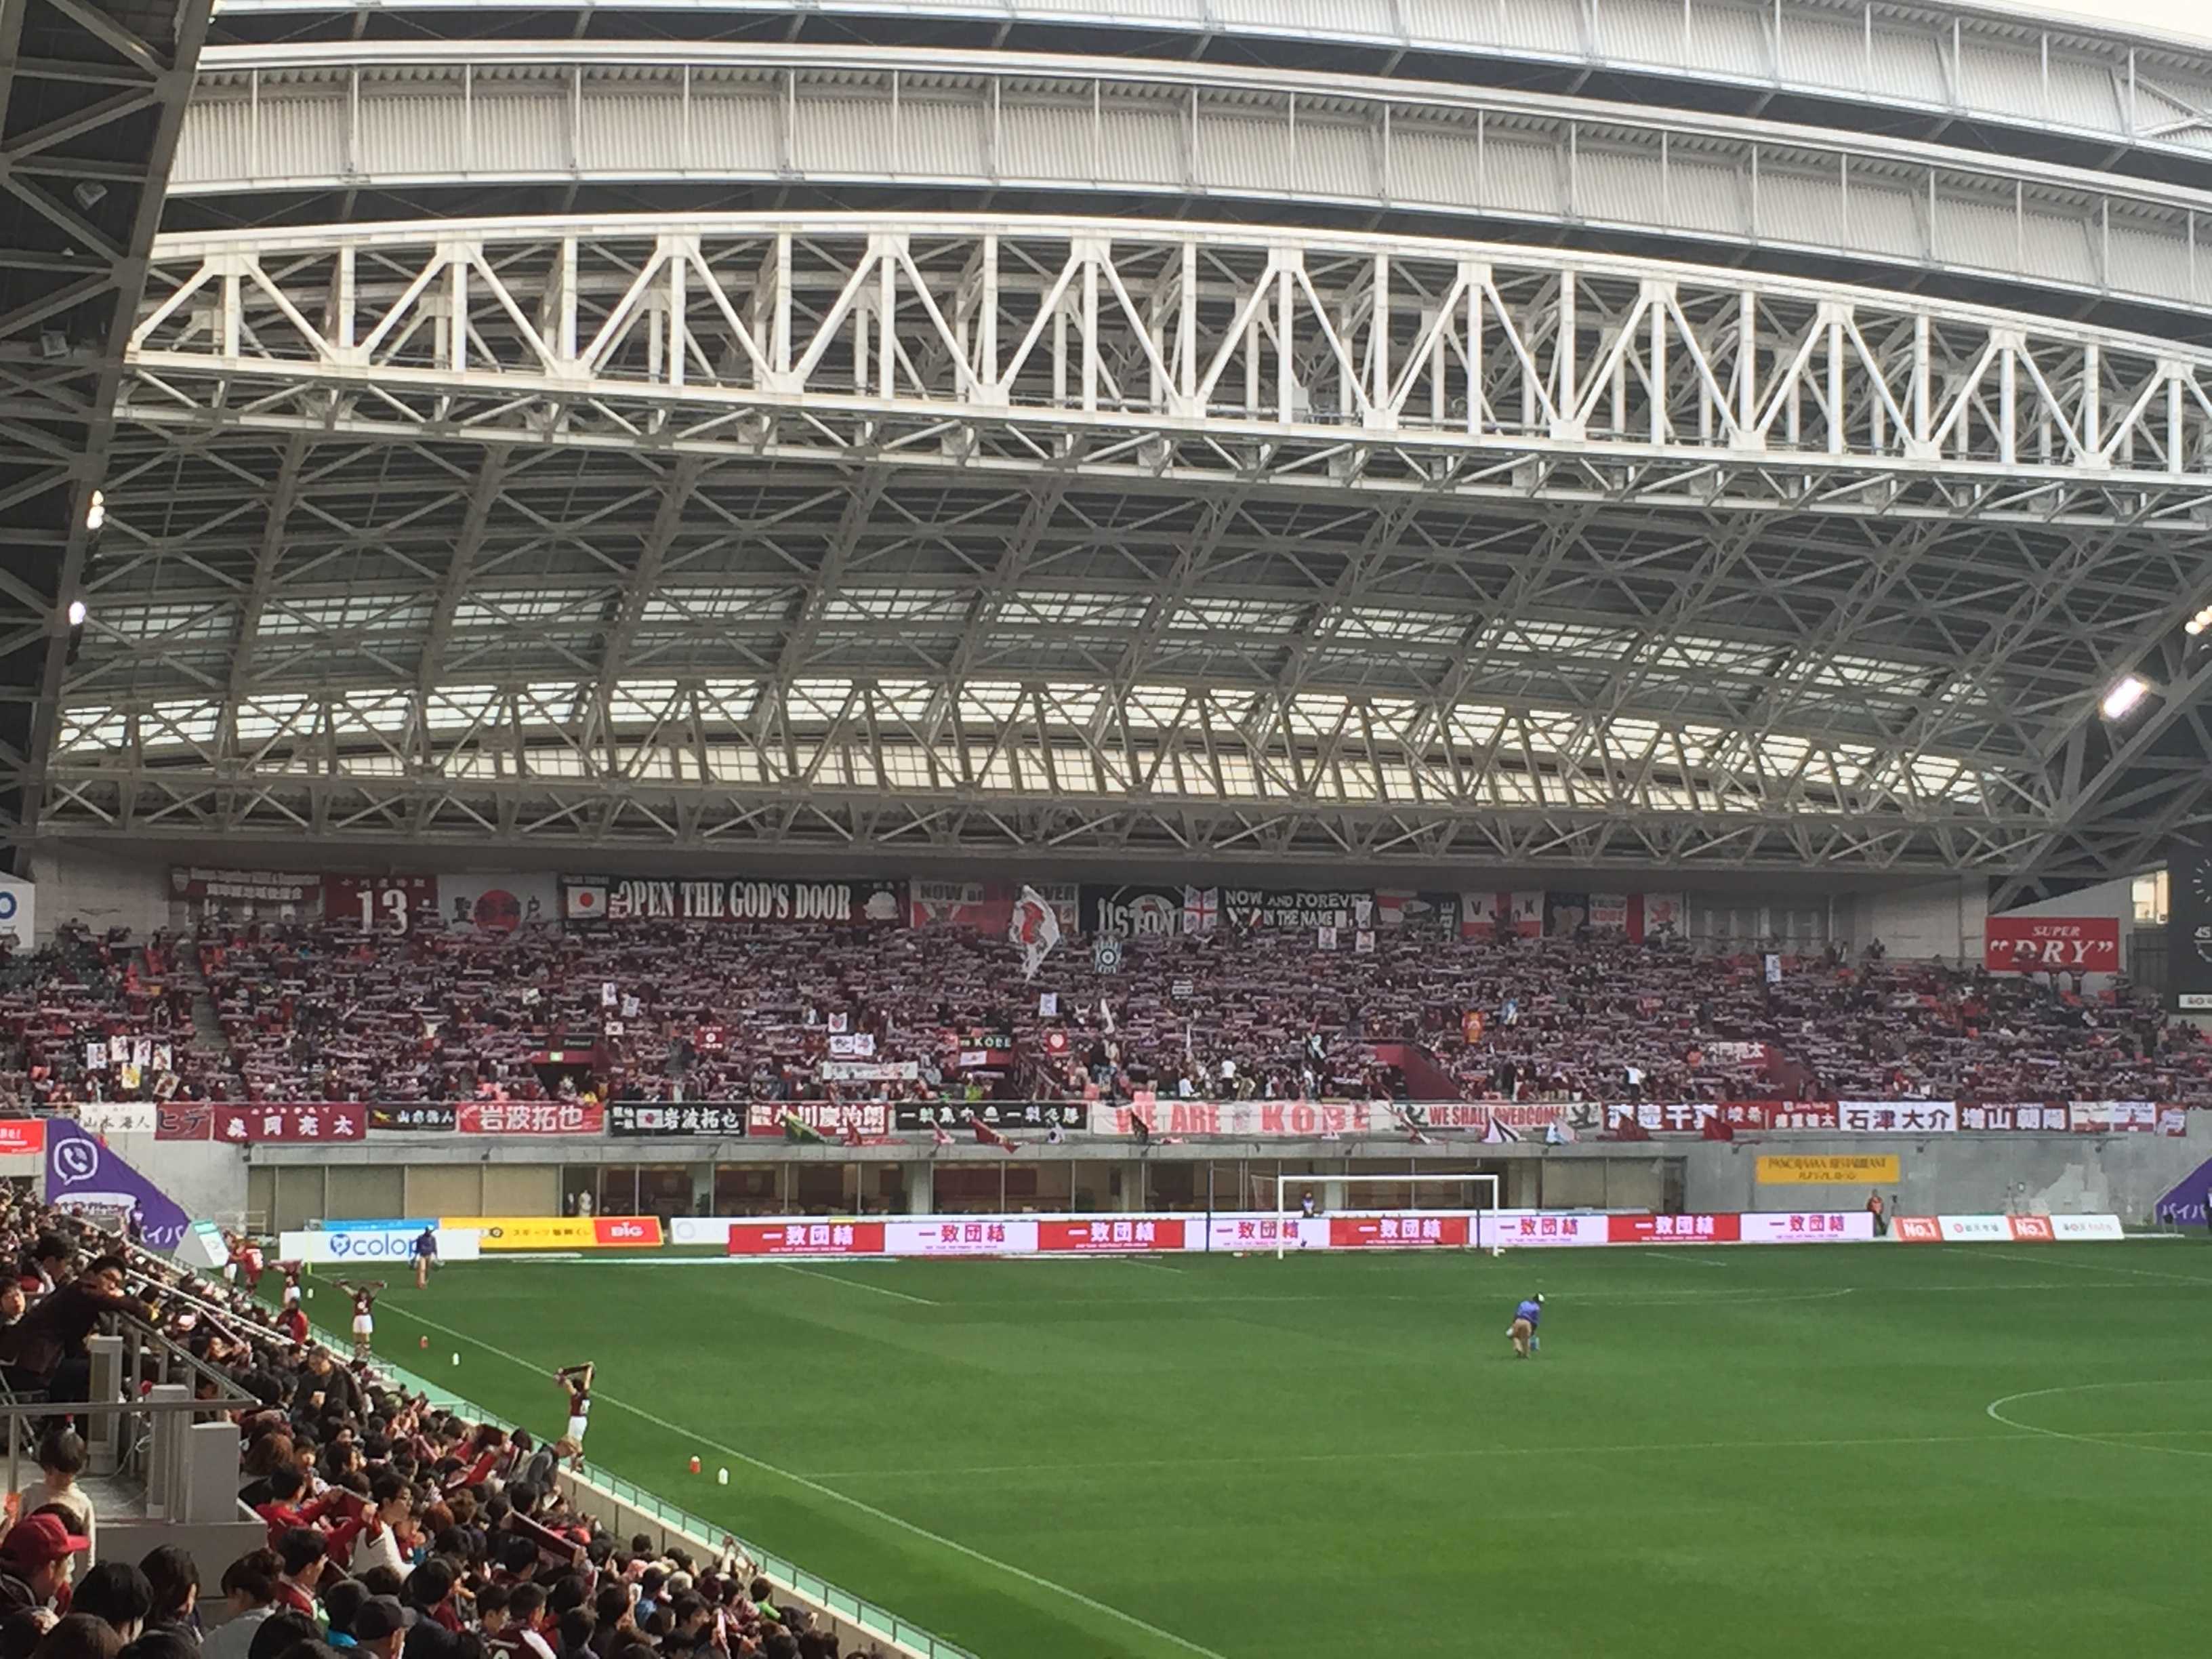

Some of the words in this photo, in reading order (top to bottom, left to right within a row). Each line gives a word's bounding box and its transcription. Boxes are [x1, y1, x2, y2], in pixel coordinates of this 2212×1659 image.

[619, 880, 674, 917] OPEN
[680, 882, 724, 917] THE
[730, 882, 789, 919] GOD'S
[795, 884, 851, 920] DOOR
[1225, 890, 1262, 905] NOW
[1267, 895, 1293, 907] AND
[356, 889, 408, 936] 13
[1277, 909, 1298, 926] THE
[2032, 926, 2082, 937] SUPER
[480, 1105, 583, 1131] 岩波拓也
[663, 1107, 739, 1130] 岩波拓也
[1170, 1105, 1221, 1132] ARE
[1261, 1104, 1370, 1132] KOBE
[1431, 1107, 1450, 1125] WE
[1846, 1108, 1950, 1130] 石津大介
[918, 1223, 1006, 1243] 一致団結
[1067, 1221, 1156, 1242] 一致団結
[1216, 1221, 1300, 1240] 一致団結
[1358, 1218, 1441, 1239] 一致団結
[1500, 1218, 1578, 1236] 一致団結
[1635, 1215, 1715, 1235] 一致団結
[1769, 1214, 1845, 1233] 一致団結
[1903, 1222, 1938, 1237] No.1
[762, 1225, 854, 1246] 一致団結
